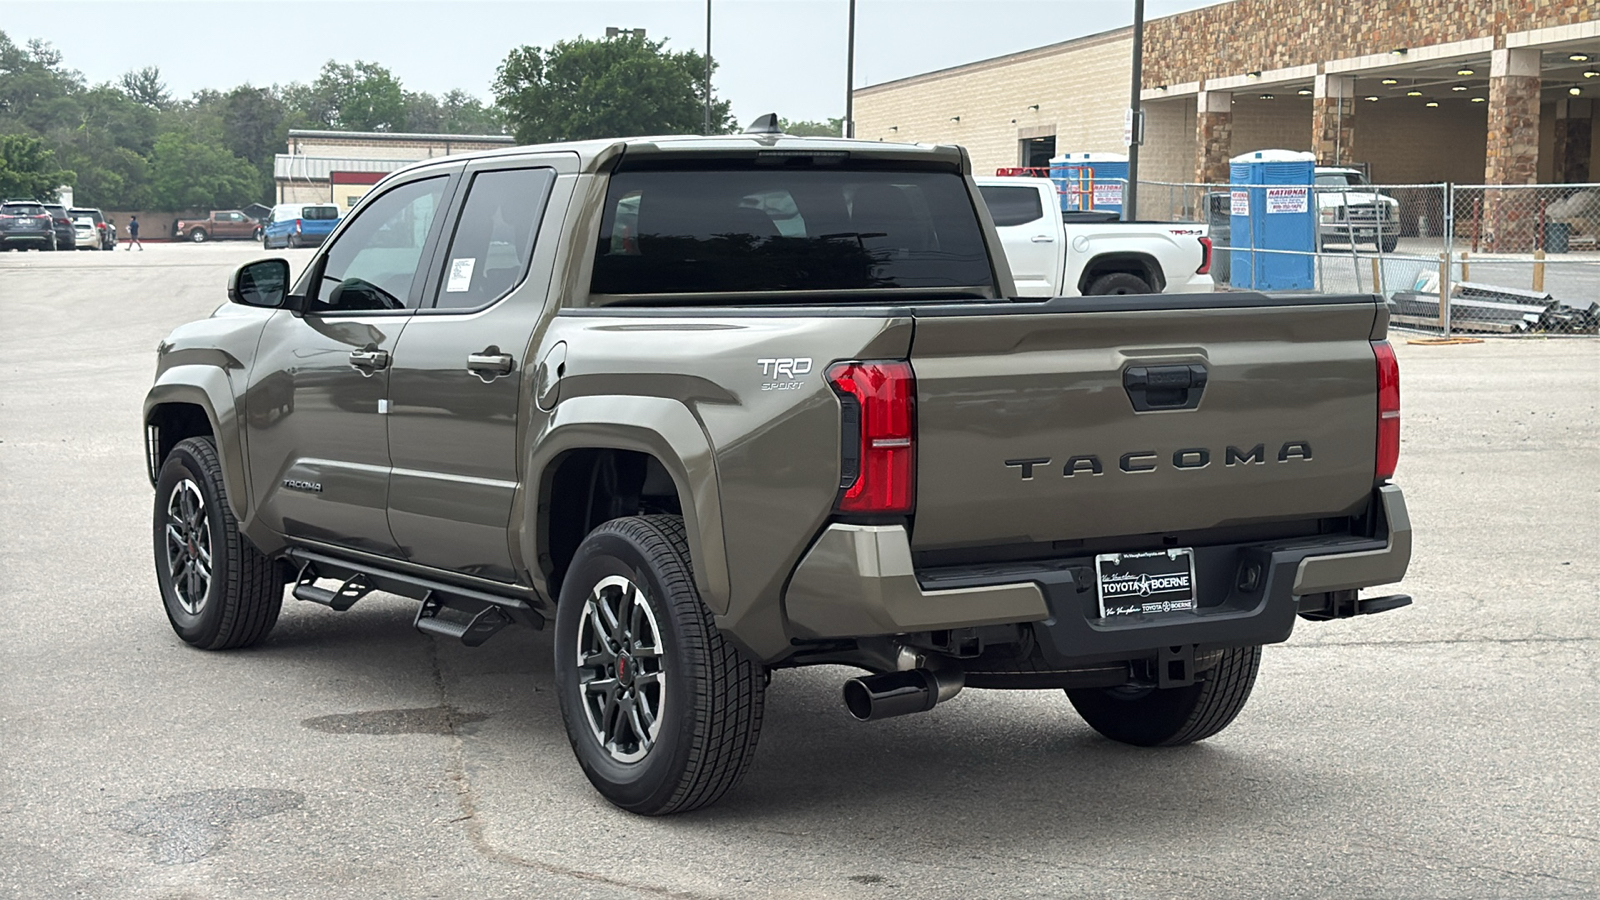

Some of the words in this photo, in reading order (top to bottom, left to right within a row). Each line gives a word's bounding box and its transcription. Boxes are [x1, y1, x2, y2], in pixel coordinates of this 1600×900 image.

[757, 358, 812, 379] TRD
[761, 382, 804, 391] SPORT
[1004, 440, 1313, 481] TACOMA
[283, 480, 323, 492] TACOMA
[1103, 582, 1139, 593] TOYOTA
[1151, 577, 1189, 589] BOERNE
[1142, 604, 1162, 612] TOYOTA
